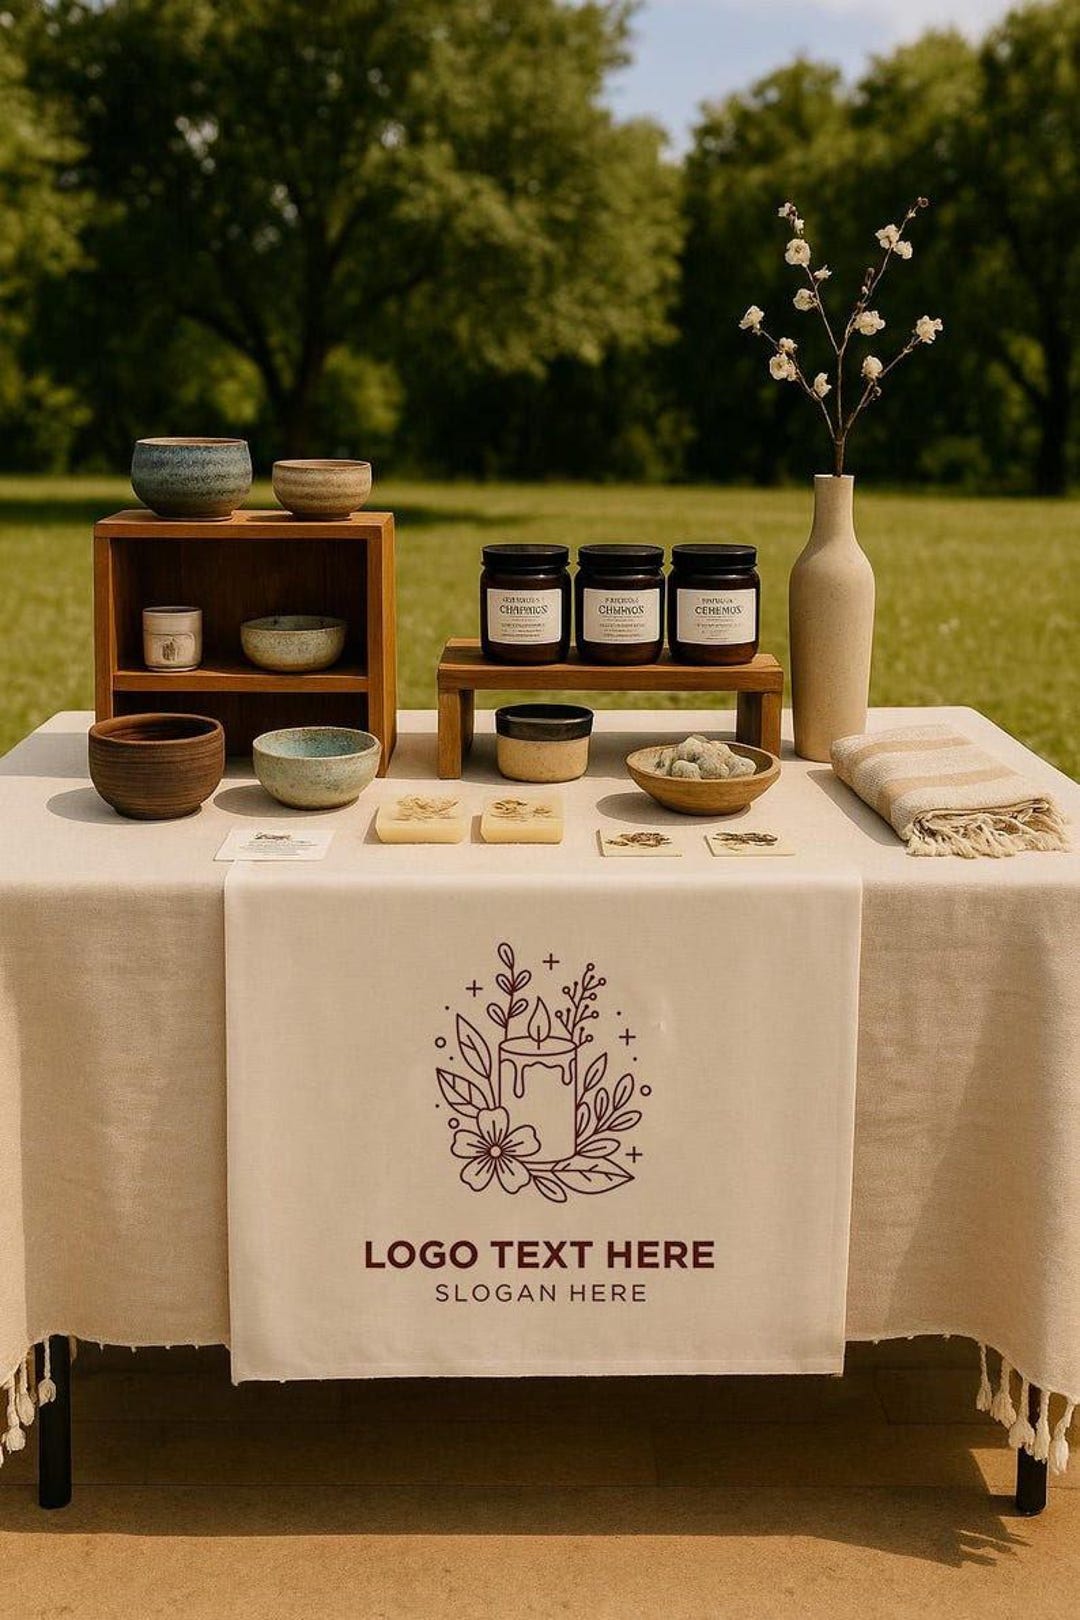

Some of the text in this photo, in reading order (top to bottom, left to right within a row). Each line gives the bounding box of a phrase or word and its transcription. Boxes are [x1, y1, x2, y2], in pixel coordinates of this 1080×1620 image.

[365, 1240, 715, 1269] LOGO TEXT HERE
[435, 1283, 647, 1302] SLOGAN HERE
